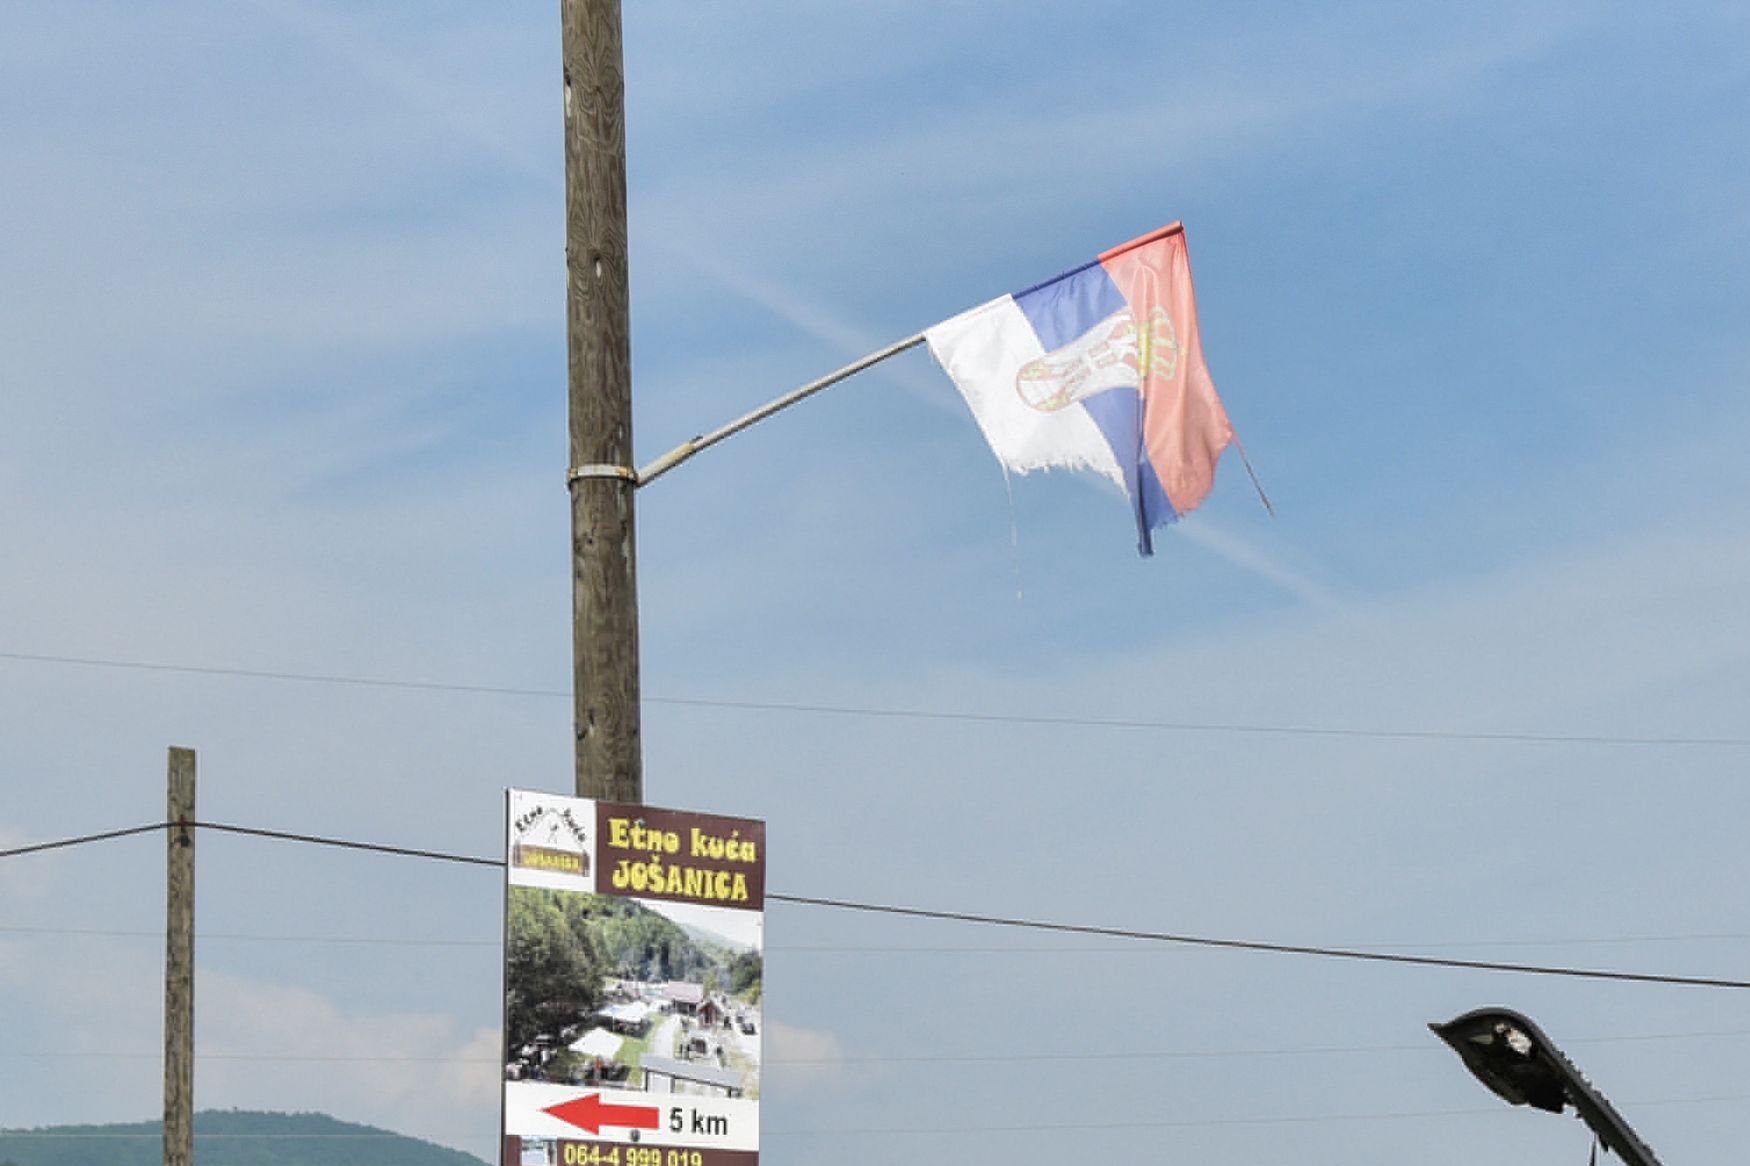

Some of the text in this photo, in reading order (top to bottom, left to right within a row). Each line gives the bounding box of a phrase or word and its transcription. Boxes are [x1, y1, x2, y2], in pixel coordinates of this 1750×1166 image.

[608, 817, 680, 854] Etno
[690, 828, 756, 863] kuća
[612, 854, 748, 901] JOŠANICA
[669, 1107, 728, 1135] 5 km
